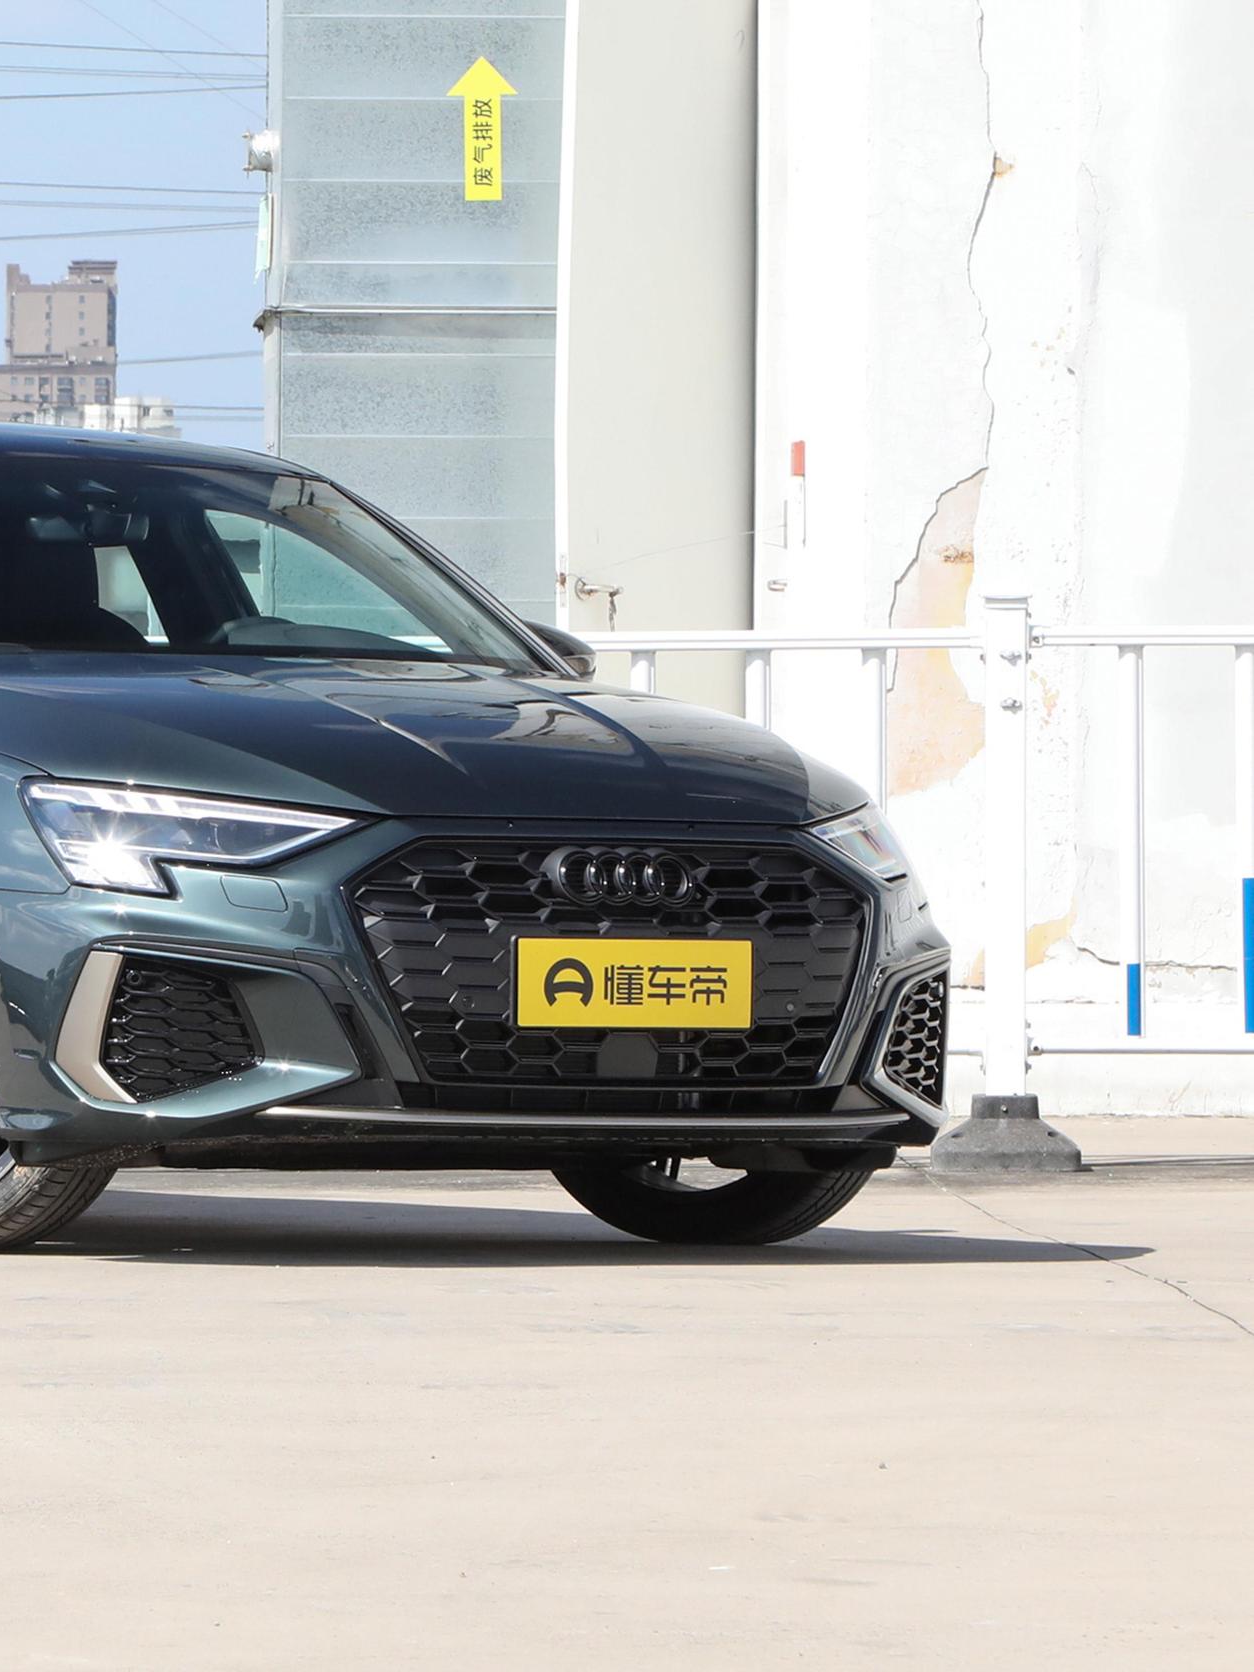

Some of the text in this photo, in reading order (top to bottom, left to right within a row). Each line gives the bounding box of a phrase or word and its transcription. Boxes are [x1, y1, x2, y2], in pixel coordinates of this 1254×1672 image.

[473, 99, 493, 186] 废气排放
[604, 965, 728, 1006] 懂车帝
